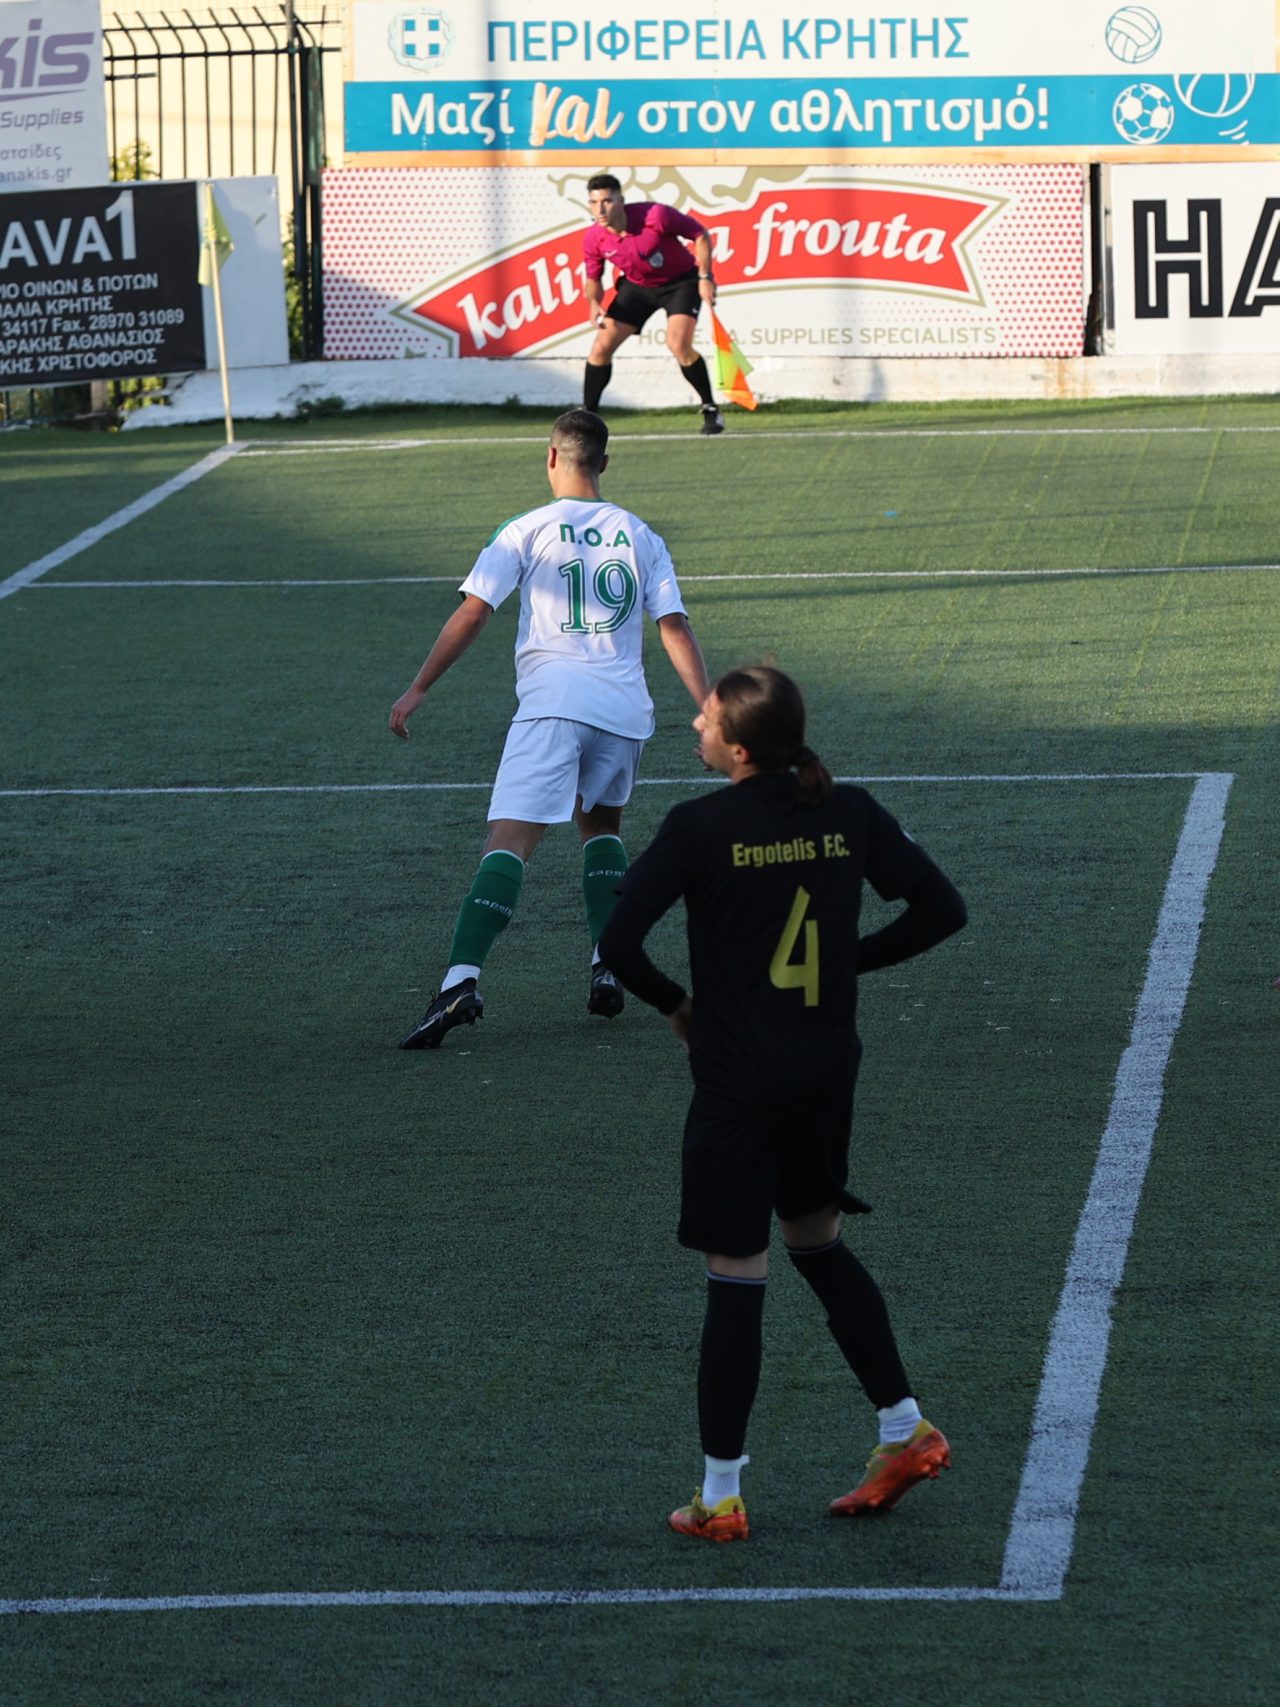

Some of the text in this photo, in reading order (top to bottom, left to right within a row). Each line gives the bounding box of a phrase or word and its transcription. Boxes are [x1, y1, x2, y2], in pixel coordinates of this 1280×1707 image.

[487, 16, 971, 63] ΠΕΡΙΦΕΡΕΙΑ ΚΡΗΤΗΣ
[0, 109, 85, 131] Supplies
[391, 88, 515, 145] Μαζί
[637, 98, 756, 134] στον
[770, 82, 1050, 143] αθλητισμό!
[743, 200, 947, 278] frouta
[23, 278, 78, 298] ΟΙΝΩΝ
[82, 277, 95, 293] &
[98, 273, 158, 292] ΠΟΤΩΝ
[46, 295, 113, 315] ΚΡΗΤΗΣ
[2, 317, 48, 337] 34117
[52, 315, 85, 333] Fax.
[89, 311, 135, 331] 28970
[138, 307, 185, 326] 31089
[751, 327, 854, 345] SUPPLIES
[859, 326, 996, 345] SPECIALISTS
[67, 327, 165, 351] ΑΘΑΝΑΣΙΟΣ
[37, 348, 158, 372] ΧΡΙΣΤΟΦΟΡΟΣ
[558, 558, 638, 634] 19
[732, 832, 851, 868] Ergotelis F.C.
[769, 885, 819, 1007] 4
